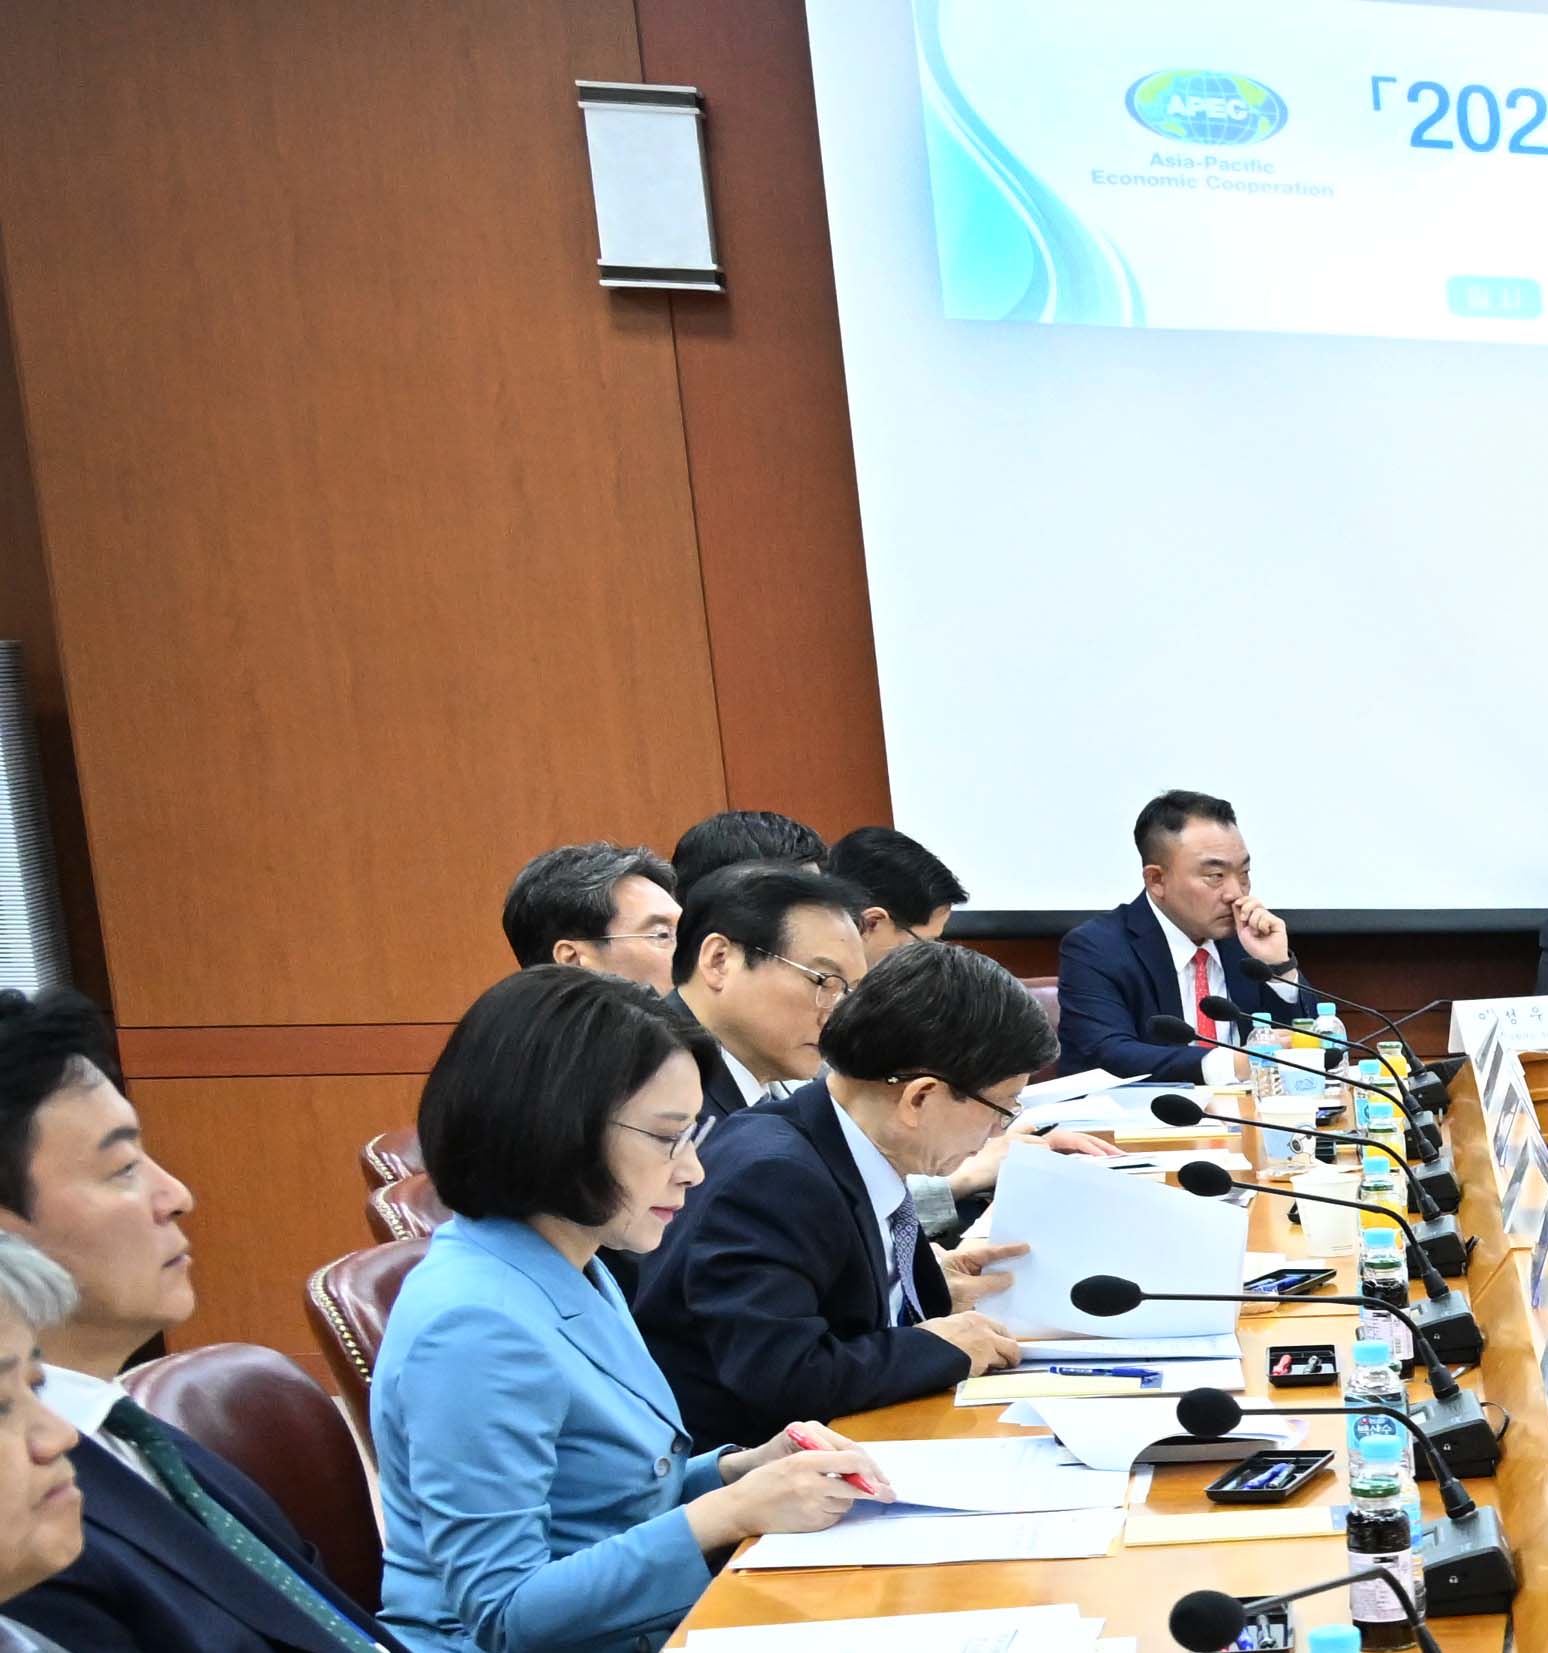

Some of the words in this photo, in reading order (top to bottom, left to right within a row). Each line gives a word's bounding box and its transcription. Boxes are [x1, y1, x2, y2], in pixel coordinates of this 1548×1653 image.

[1167, 93, 1249, 122] APEC
[1149, 151, 1276, 176] Asia-Pacific
[1090, 168, 1198, 190] Economic
[1205, 175, 1336, 198] Cooperation
